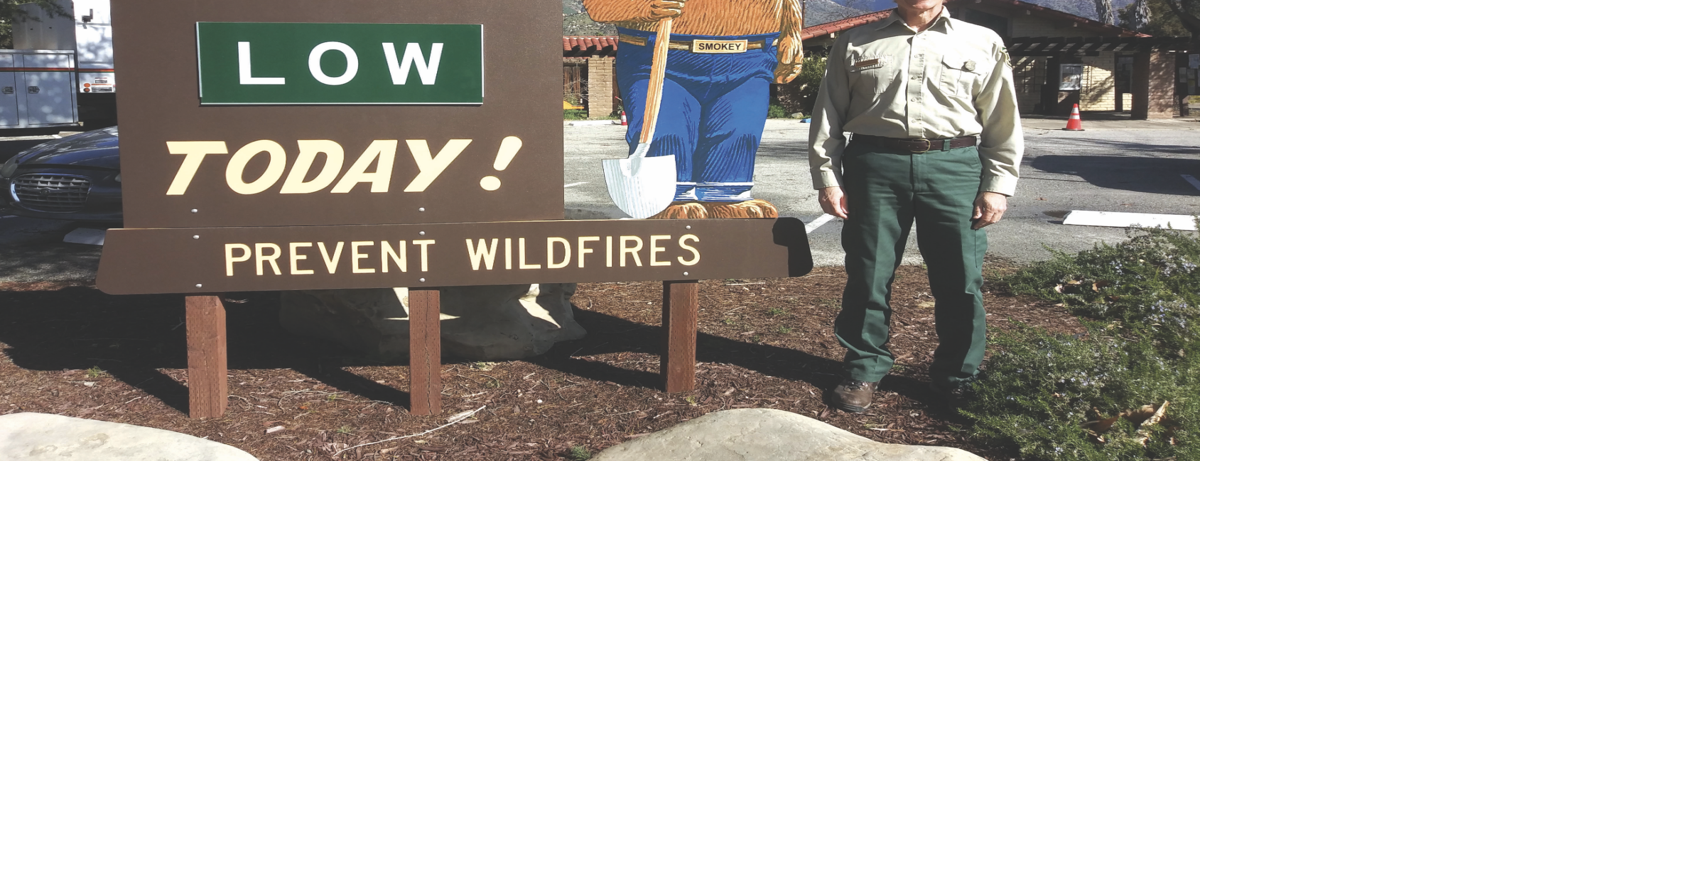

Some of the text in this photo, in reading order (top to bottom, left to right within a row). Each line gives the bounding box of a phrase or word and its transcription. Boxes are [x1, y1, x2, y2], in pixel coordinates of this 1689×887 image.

[237, 41, 444, 86] LOW
[698, 42, 742, 51] SMOKEY
[224, 233, 701, 277] PREVENT WILDFIRES
